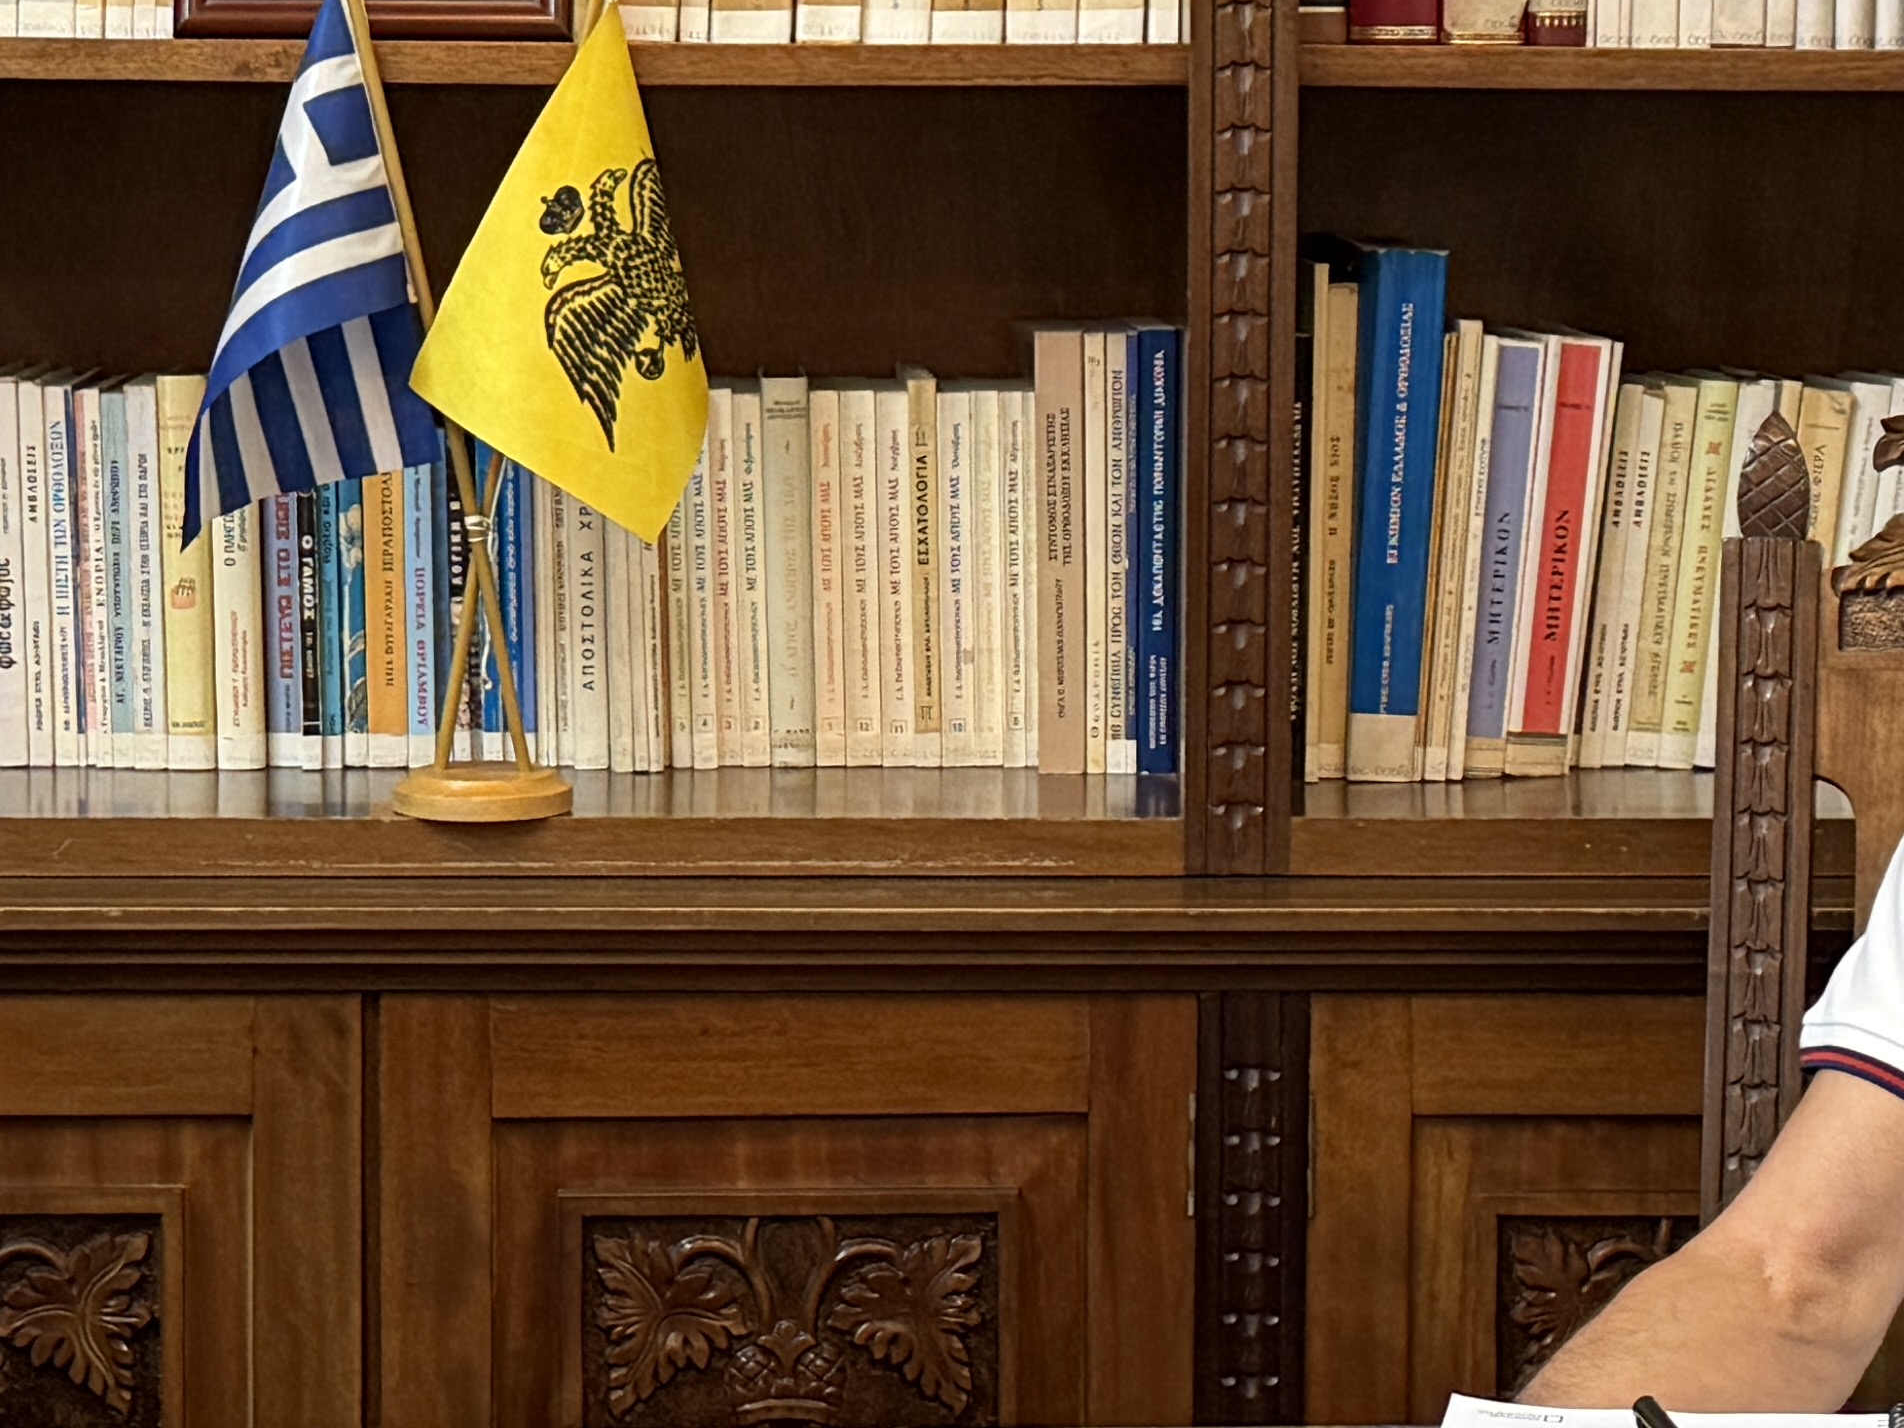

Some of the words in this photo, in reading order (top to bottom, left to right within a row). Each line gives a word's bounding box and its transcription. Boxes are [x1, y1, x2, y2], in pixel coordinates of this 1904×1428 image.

[888, 479, 899, 502] ΜΑΣ
[915, 456, 929, 565] ΕΣΧΑΤΟΛΟΓΙΑ
[1109, 494, 1122, 518] ΚΑΙ
[302, 535, 314, 548] Ο
[890, 548, 901, 576] ΤΟΥΣ
[56, 555, 69, 599] ΠΙΣΤΗ
[302, 557, 316, 620] ΓΑΜΟΣ
[1487, 511, 1511, 645] ΜΗΤΕΡΙΚΟΝ
[1543, 509, 1570, 642] ΜΗΤΕΡΙΚΟΝ
[581, 551, 595, 691] ΑΠΟΣΤΟΛΙΚΑ
